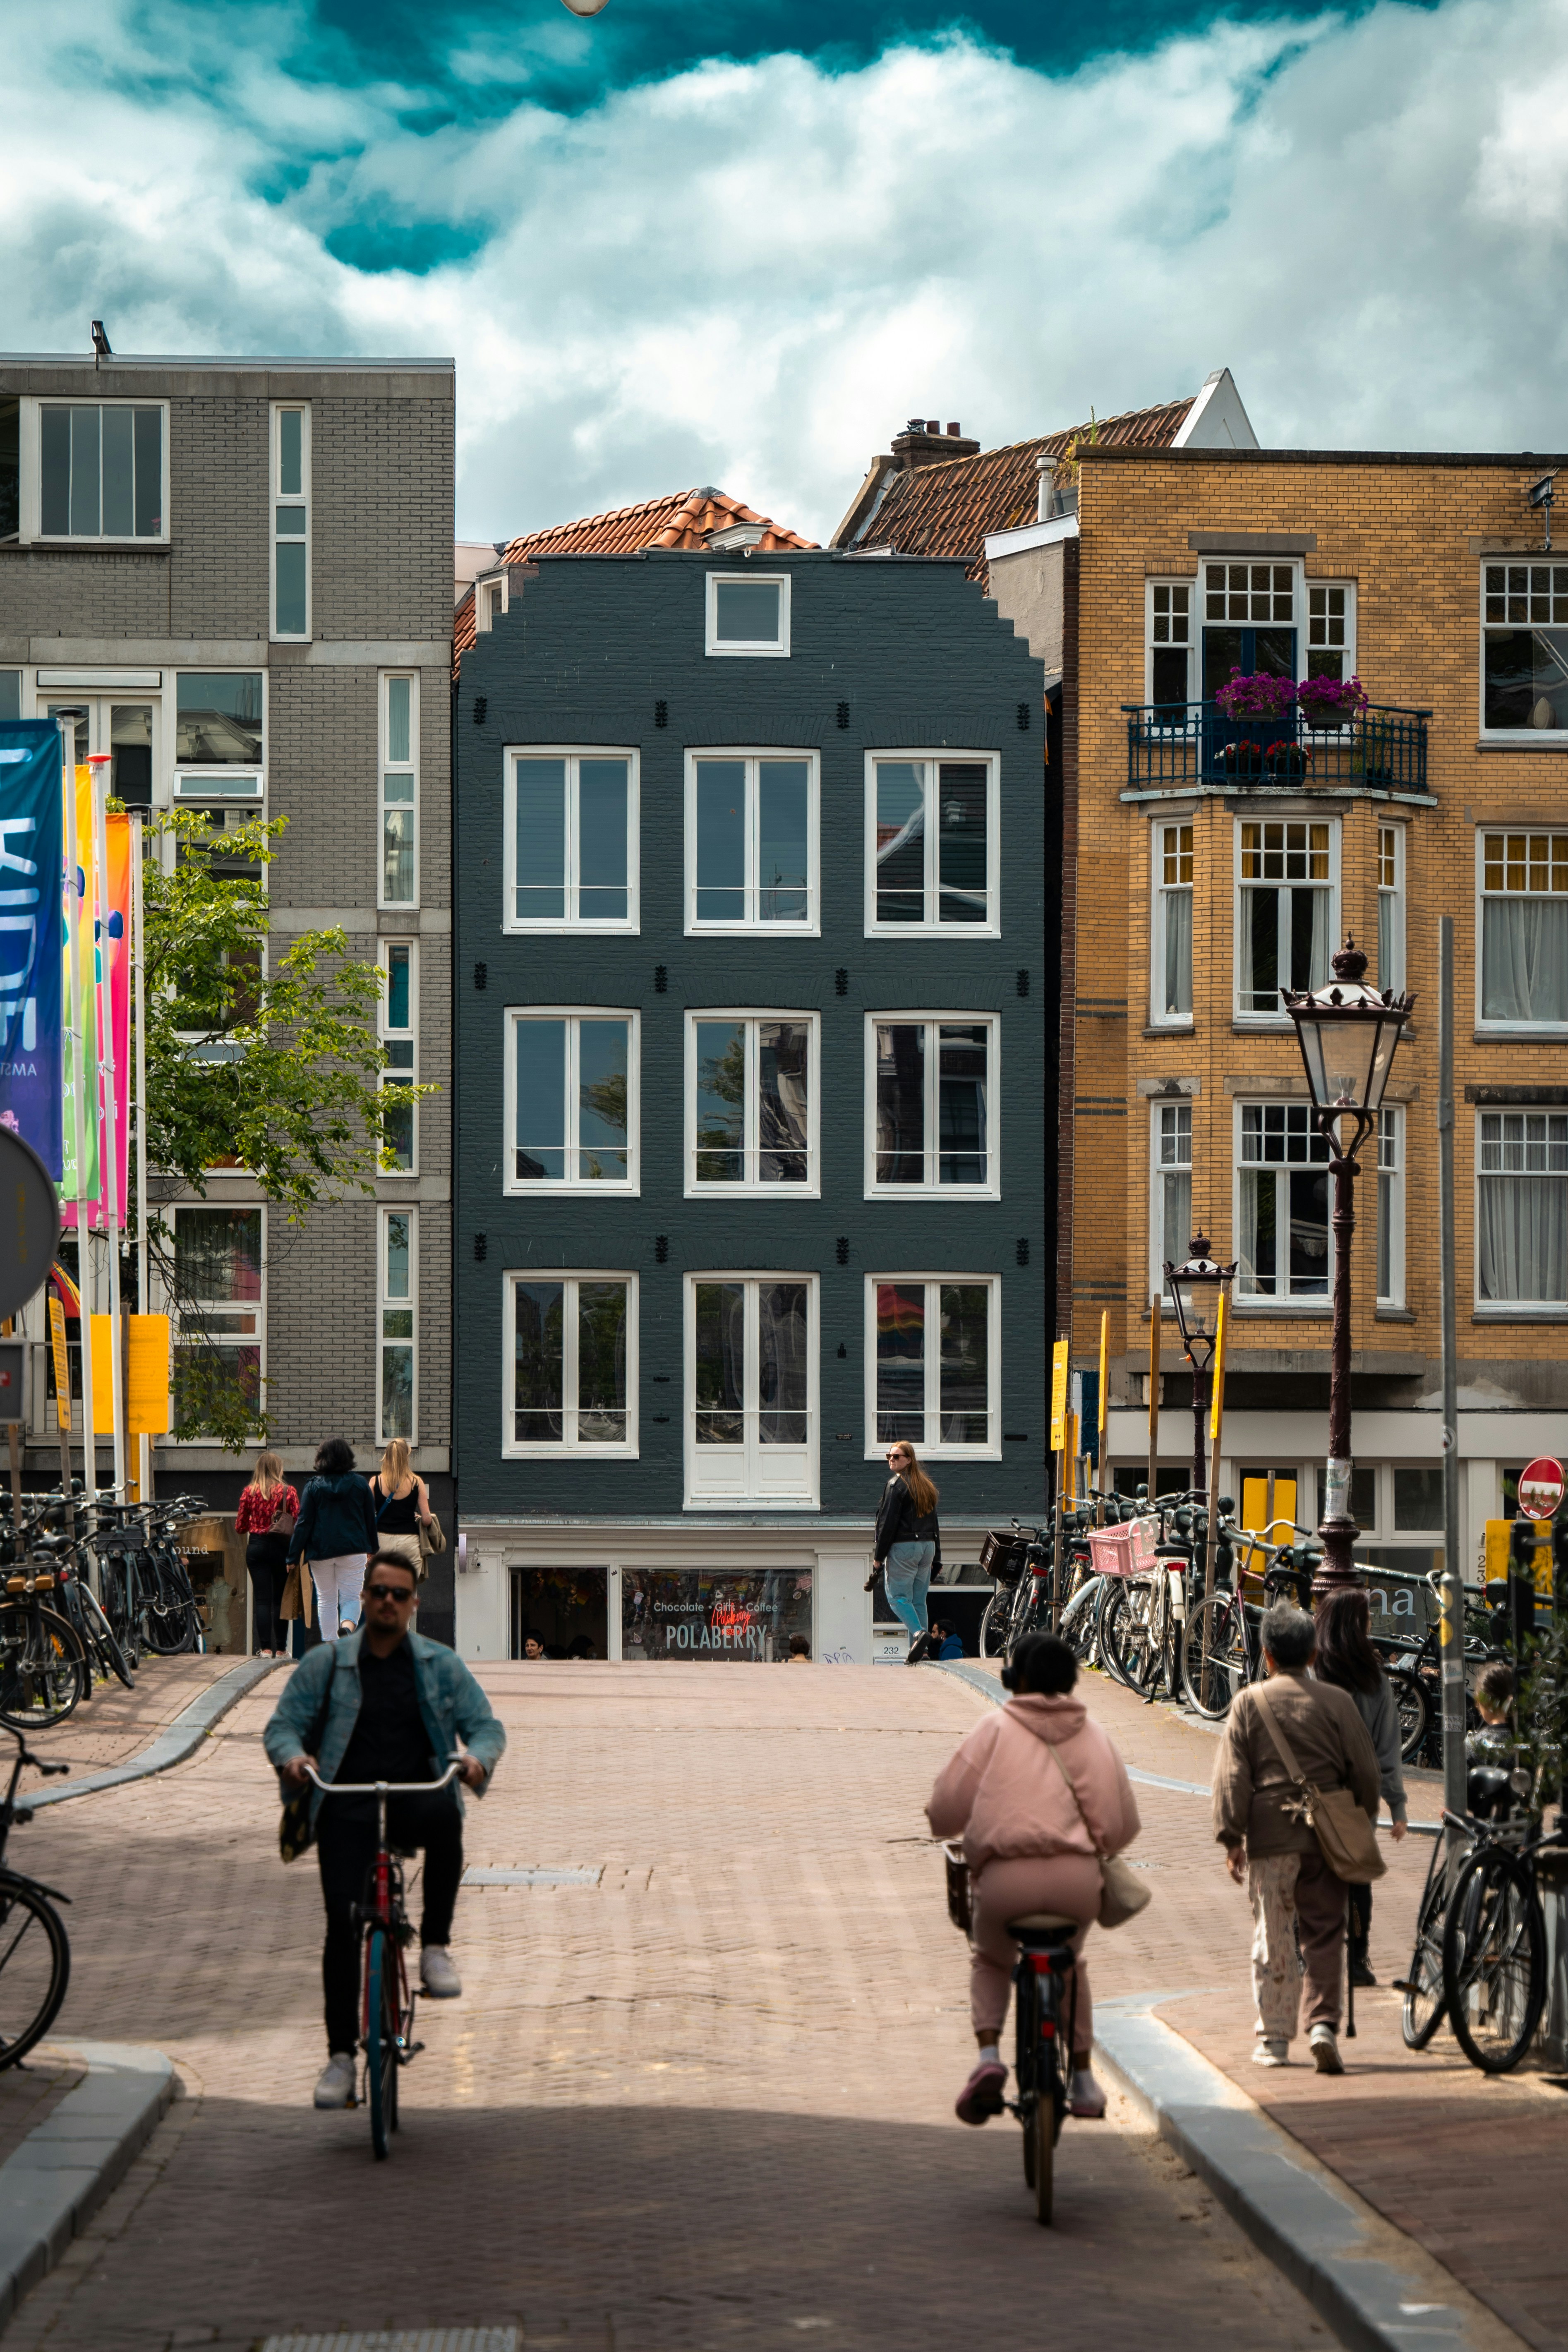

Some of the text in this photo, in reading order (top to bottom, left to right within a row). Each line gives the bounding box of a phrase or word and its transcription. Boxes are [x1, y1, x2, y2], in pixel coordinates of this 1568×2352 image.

[1477, 1555, 1486, 1585] 23
[654, 1602, 778, 1612] Chocolate Gifts Coffee
[666, 1625, 767, 1649] POLABERRY
